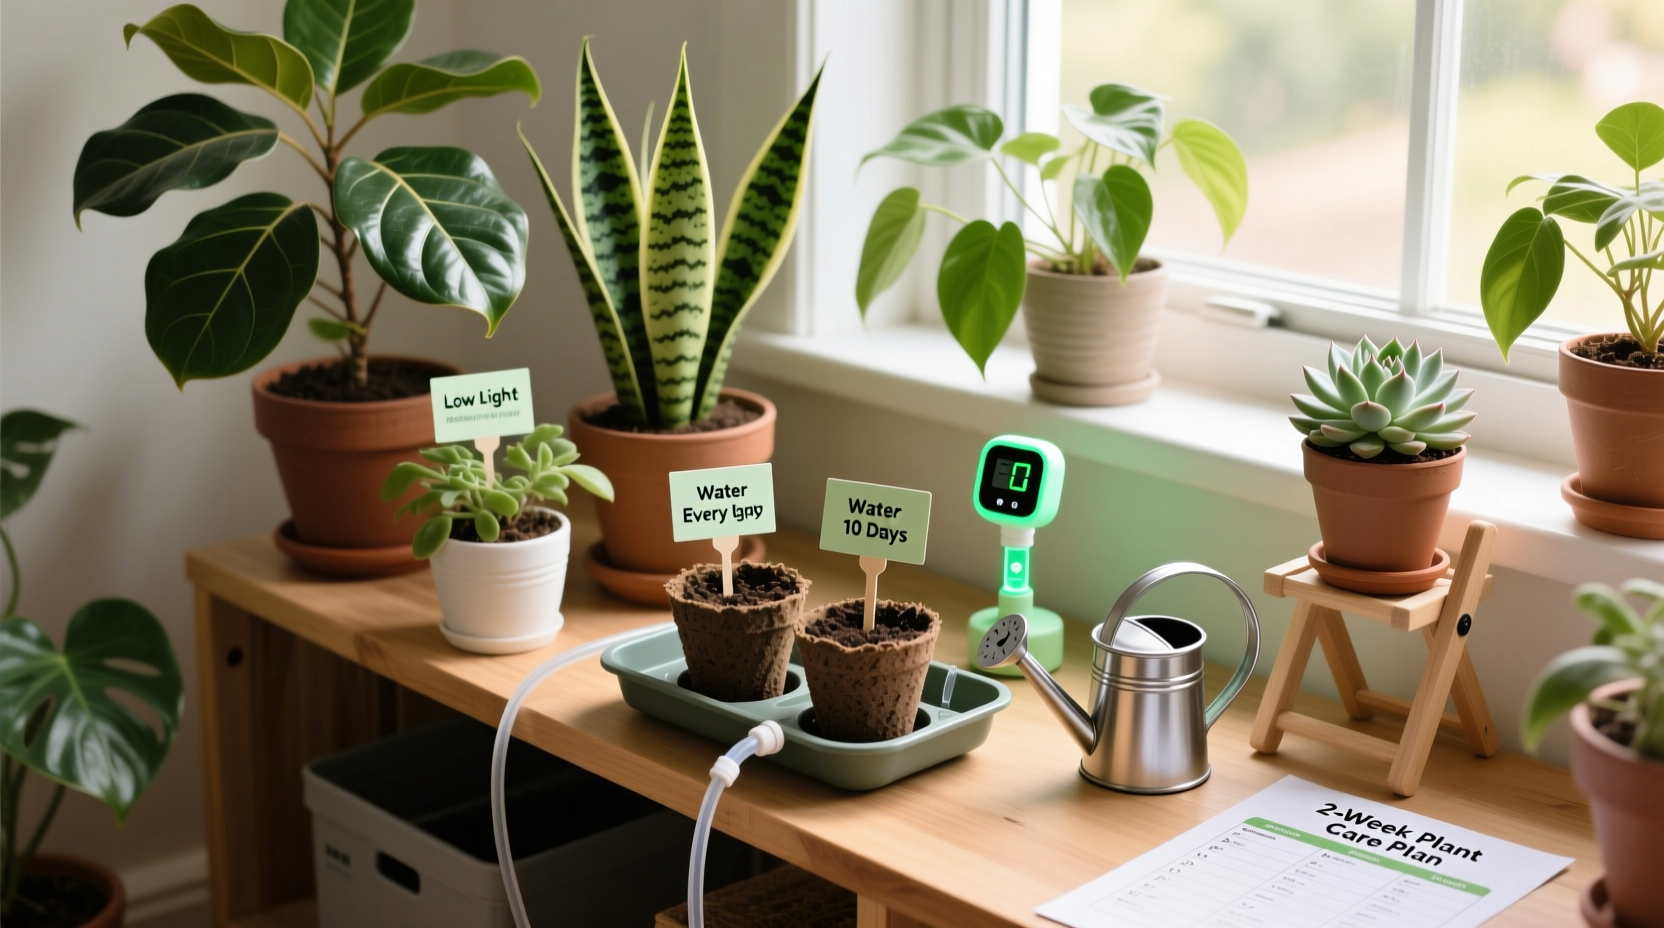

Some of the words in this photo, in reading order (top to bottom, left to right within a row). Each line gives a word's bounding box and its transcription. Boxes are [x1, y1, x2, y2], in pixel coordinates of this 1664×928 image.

[444, 393, 475, 409] Low
[479, 387, 519, 408] Light
[696, 484, 748, 501] Water
[683, 507, 728, 524] Every
[848, 497, 902, 519] Water
[843, 519, 862, 536] 10
[866, 521, 908, 546] Days
[1315, 803, 1413, 839] 2-Week
[1415, 832, 1483, 862] Plant
[1325, 823, 1383, 848] Care
[1385, 840, 1443, 867] Plan
